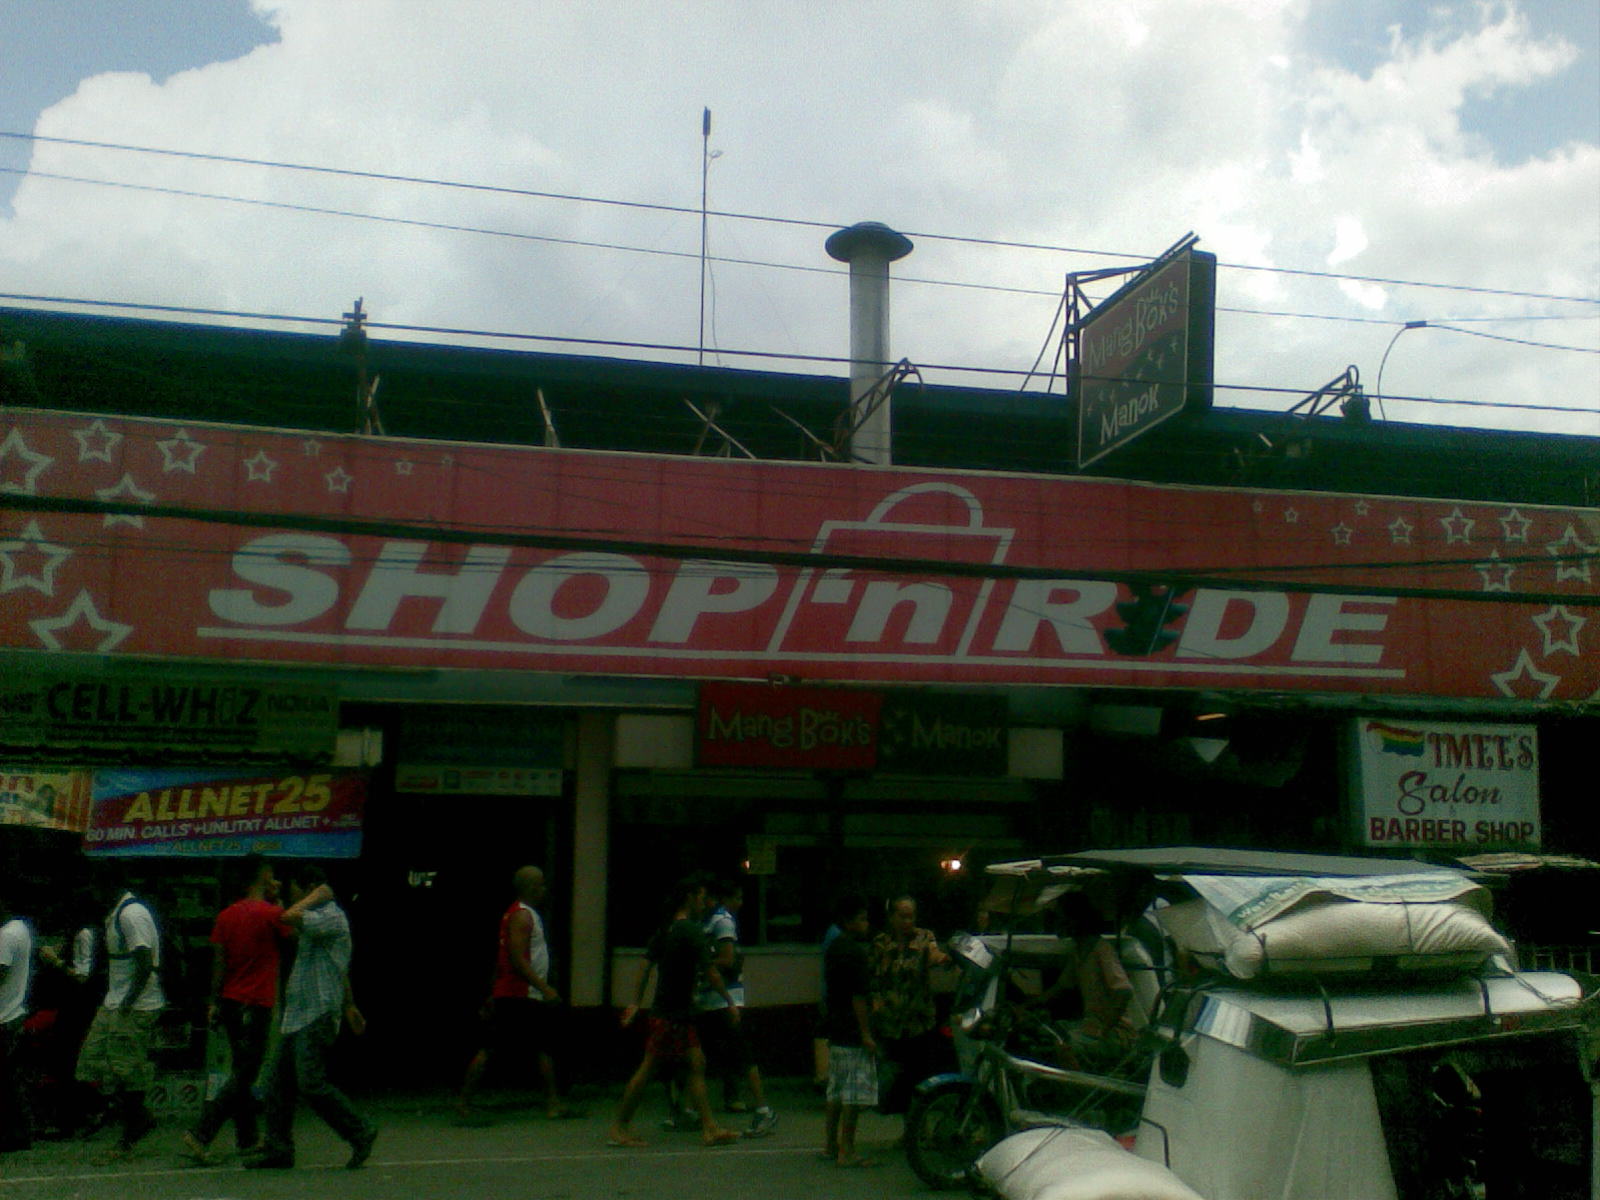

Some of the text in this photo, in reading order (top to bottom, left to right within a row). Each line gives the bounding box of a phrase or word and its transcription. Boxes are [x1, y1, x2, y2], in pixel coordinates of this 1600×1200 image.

[1100, 383, 1160, 447] Manok
[207, 532, 780, 645] SHOP
[706, 704, 794, 748] Mang
[910, 711, 1001, 749] Manok
[1397, 770, 1502, 816] Salon
[263, 815, 320, 832] ALLNET
[1370, 817, 1535, 844] BARBER SHOP
